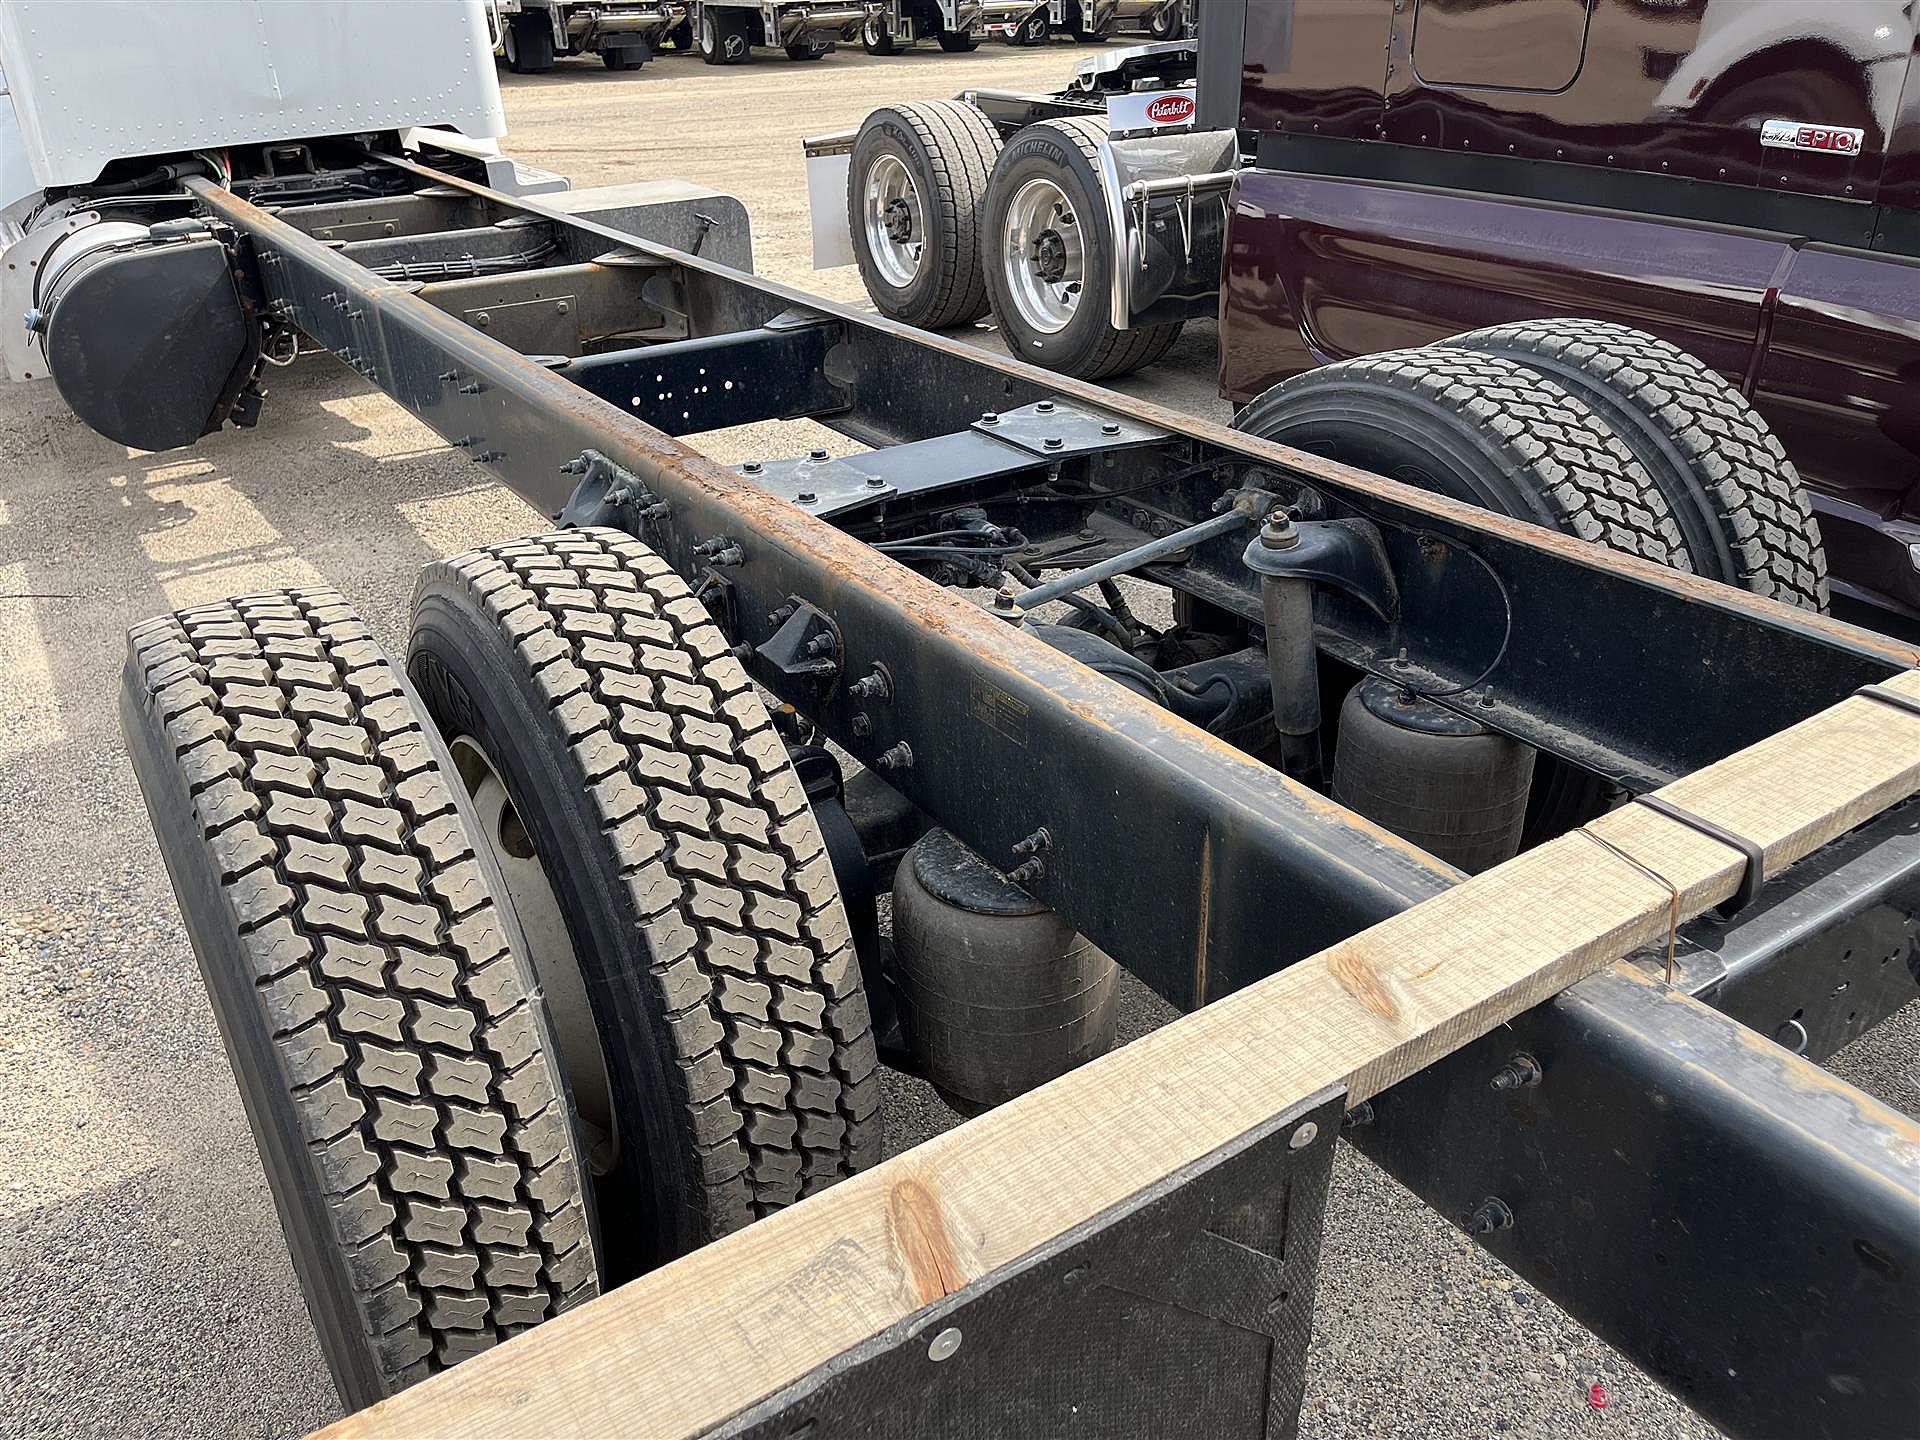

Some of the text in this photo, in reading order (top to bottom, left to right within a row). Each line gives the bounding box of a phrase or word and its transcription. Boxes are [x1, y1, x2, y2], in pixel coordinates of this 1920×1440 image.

[1151, 102, 1191, 119] Peterbilt
[1798, 128, 1853, 151] EPIQ
[1012, 140, 1063, 161] MICHELIN
